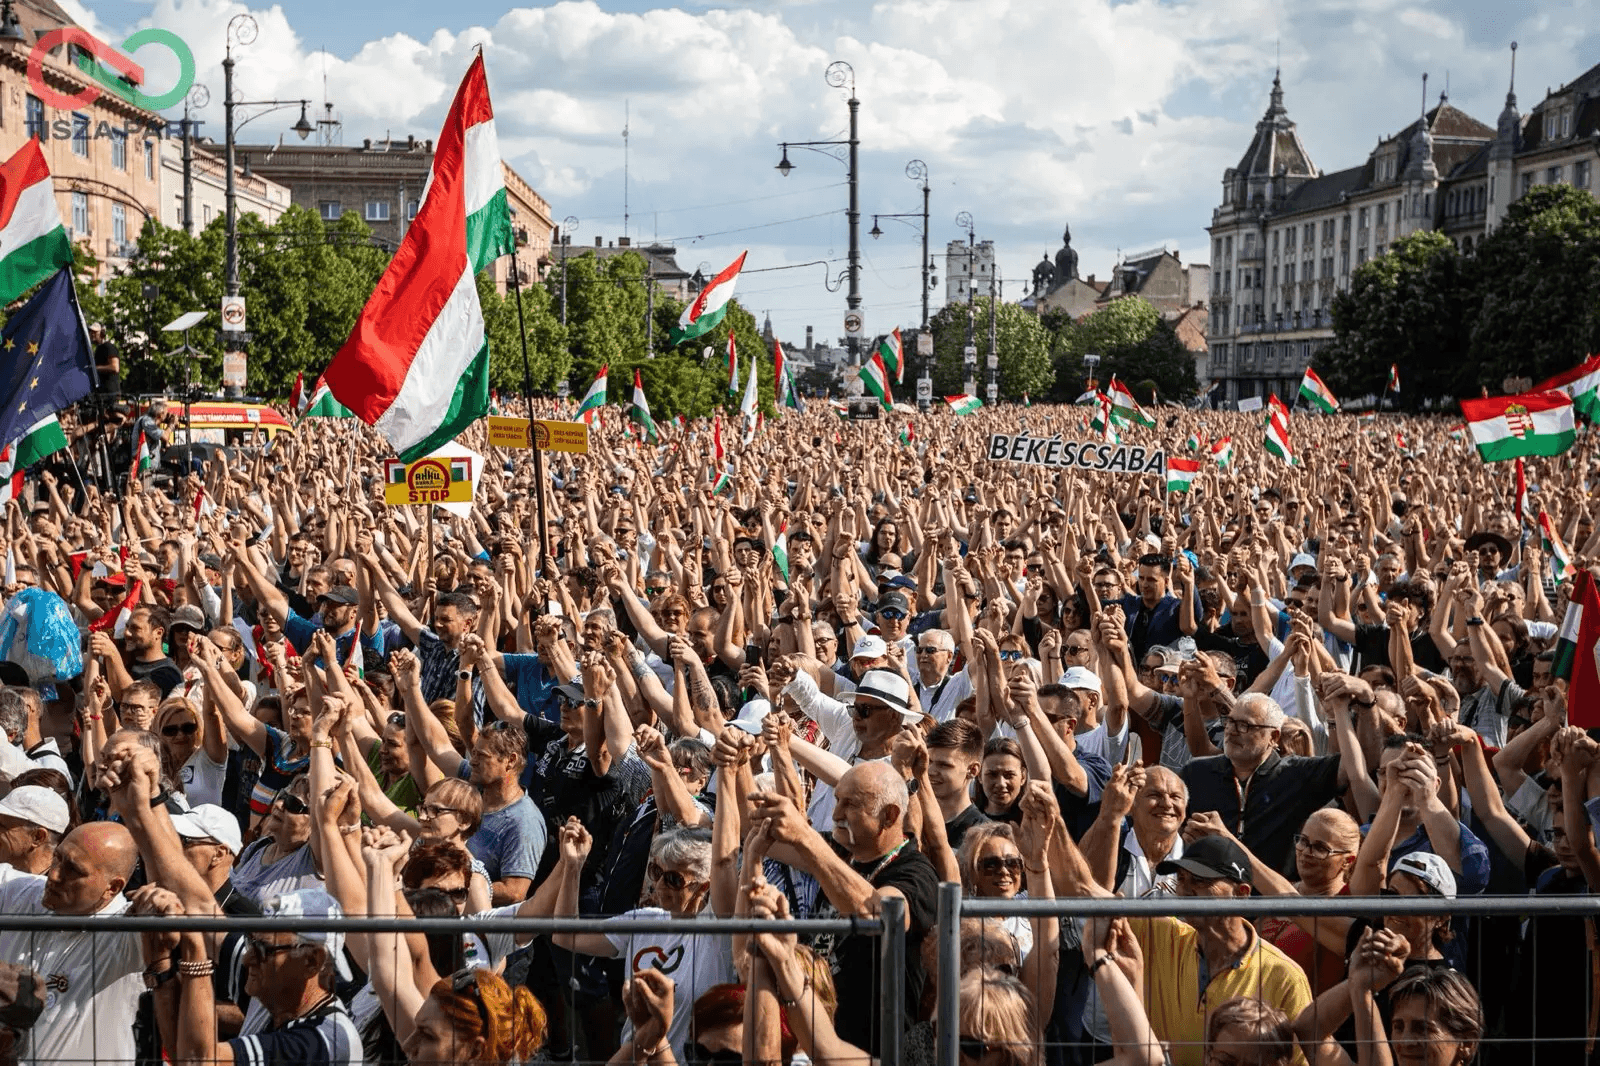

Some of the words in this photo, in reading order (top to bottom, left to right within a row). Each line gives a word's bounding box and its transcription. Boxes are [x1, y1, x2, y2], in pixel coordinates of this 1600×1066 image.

[527, 440, 550, 449] SOP
[989, 430, 1165, 475] BÉKÉSCSABA
[409, 490, 450, 502] STOP
